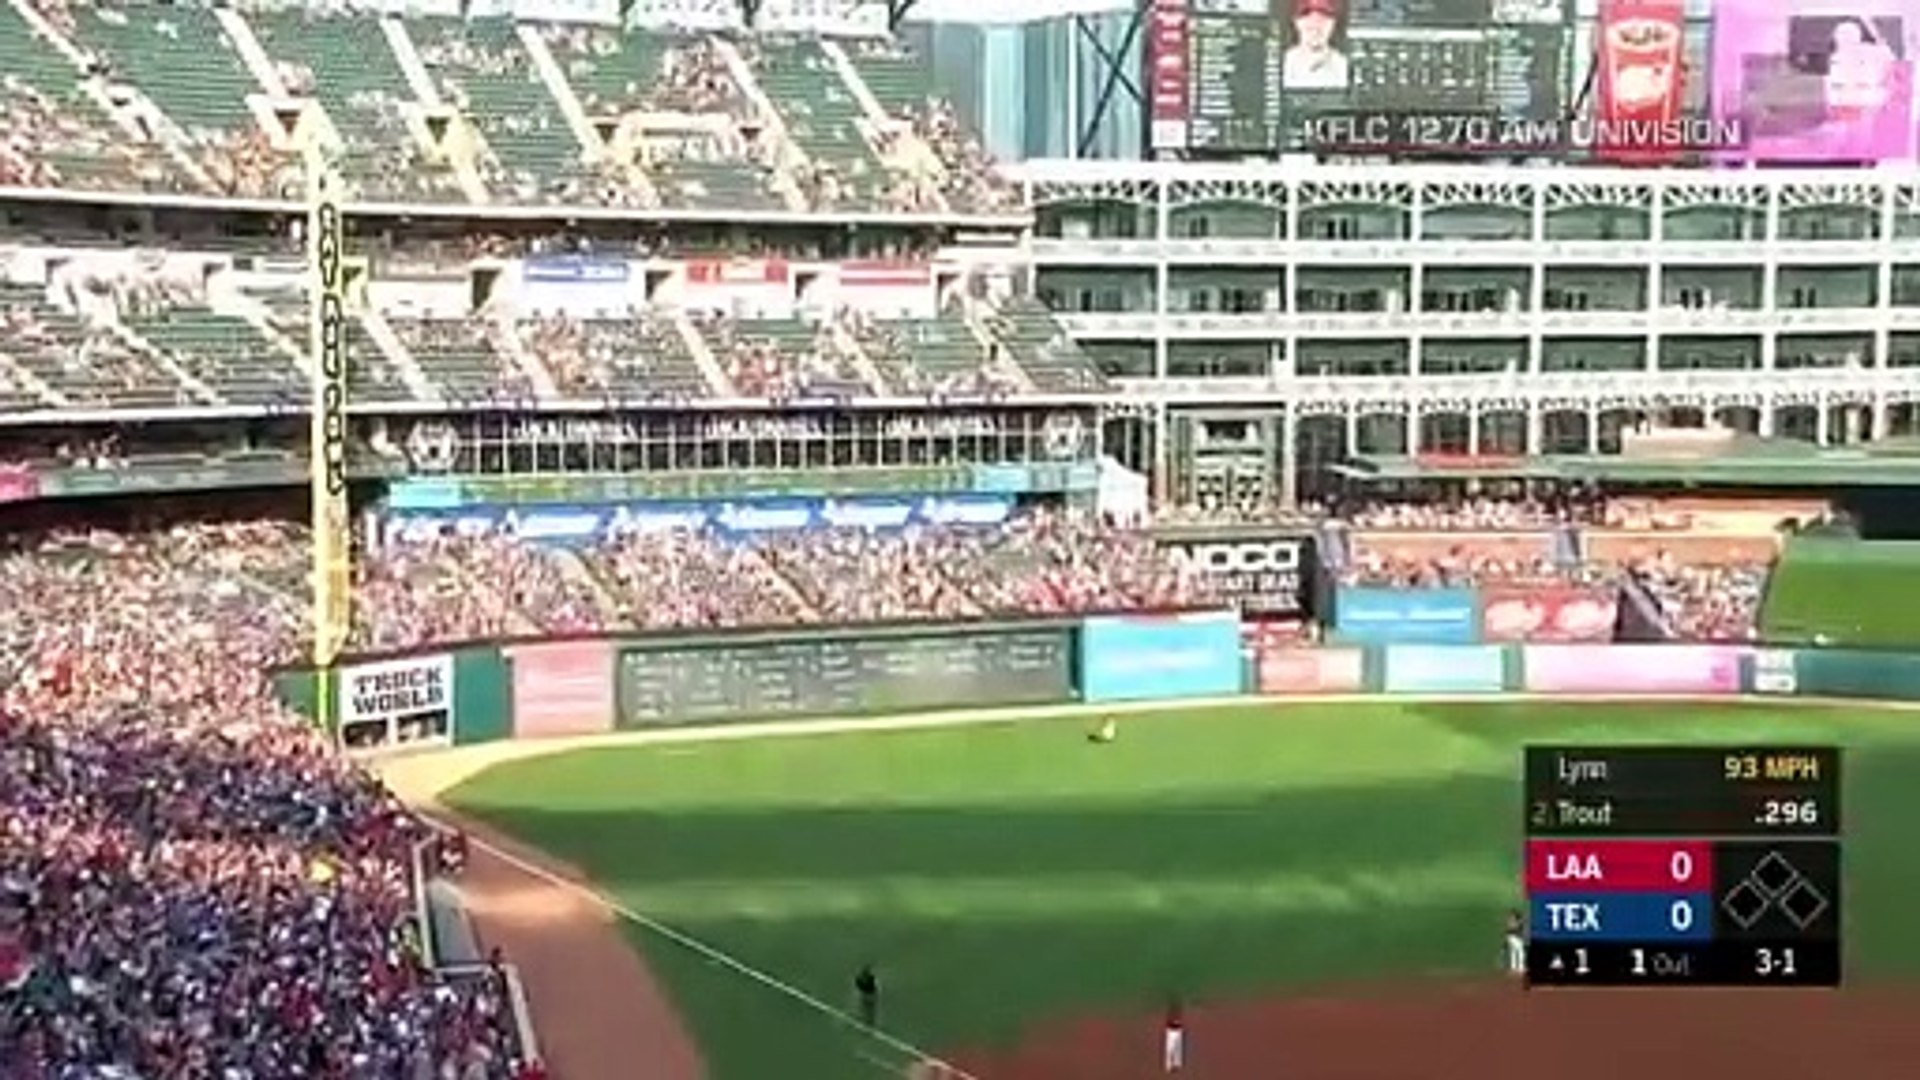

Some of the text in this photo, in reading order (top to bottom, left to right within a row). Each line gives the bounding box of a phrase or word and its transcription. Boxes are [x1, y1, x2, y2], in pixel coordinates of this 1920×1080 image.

[1168, 541, 1299, 572] NOCO
[353, 667, 442, 694] TRUCK
[353, 686, 444, 714] WORLD
